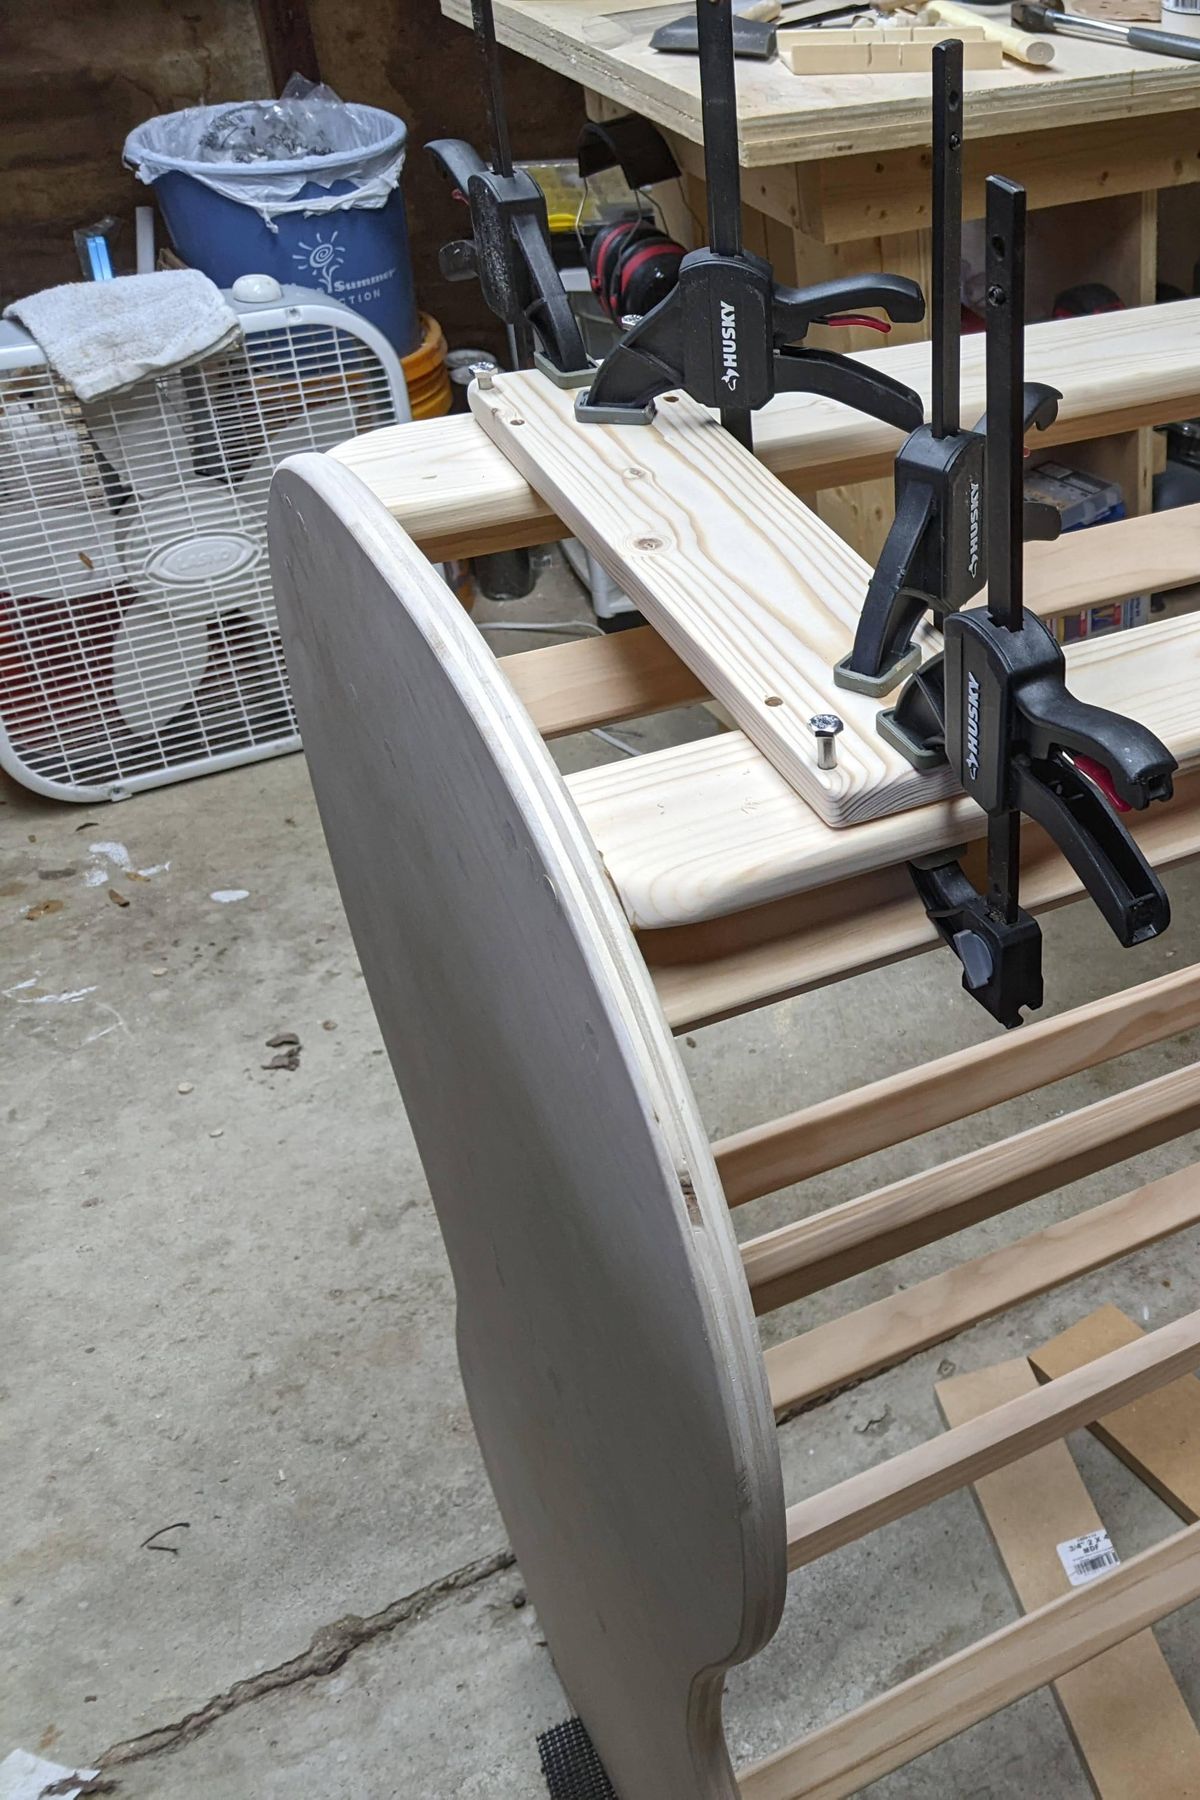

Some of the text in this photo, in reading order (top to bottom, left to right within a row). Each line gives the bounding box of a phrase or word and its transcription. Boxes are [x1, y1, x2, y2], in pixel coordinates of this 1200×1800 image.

[334, 268, 396, 292] Summer
[720, 300, 738, 367] HUSKY
[970, 483, 979, 555] HUSKY
[967, 671, 980, 755] HUSKY
